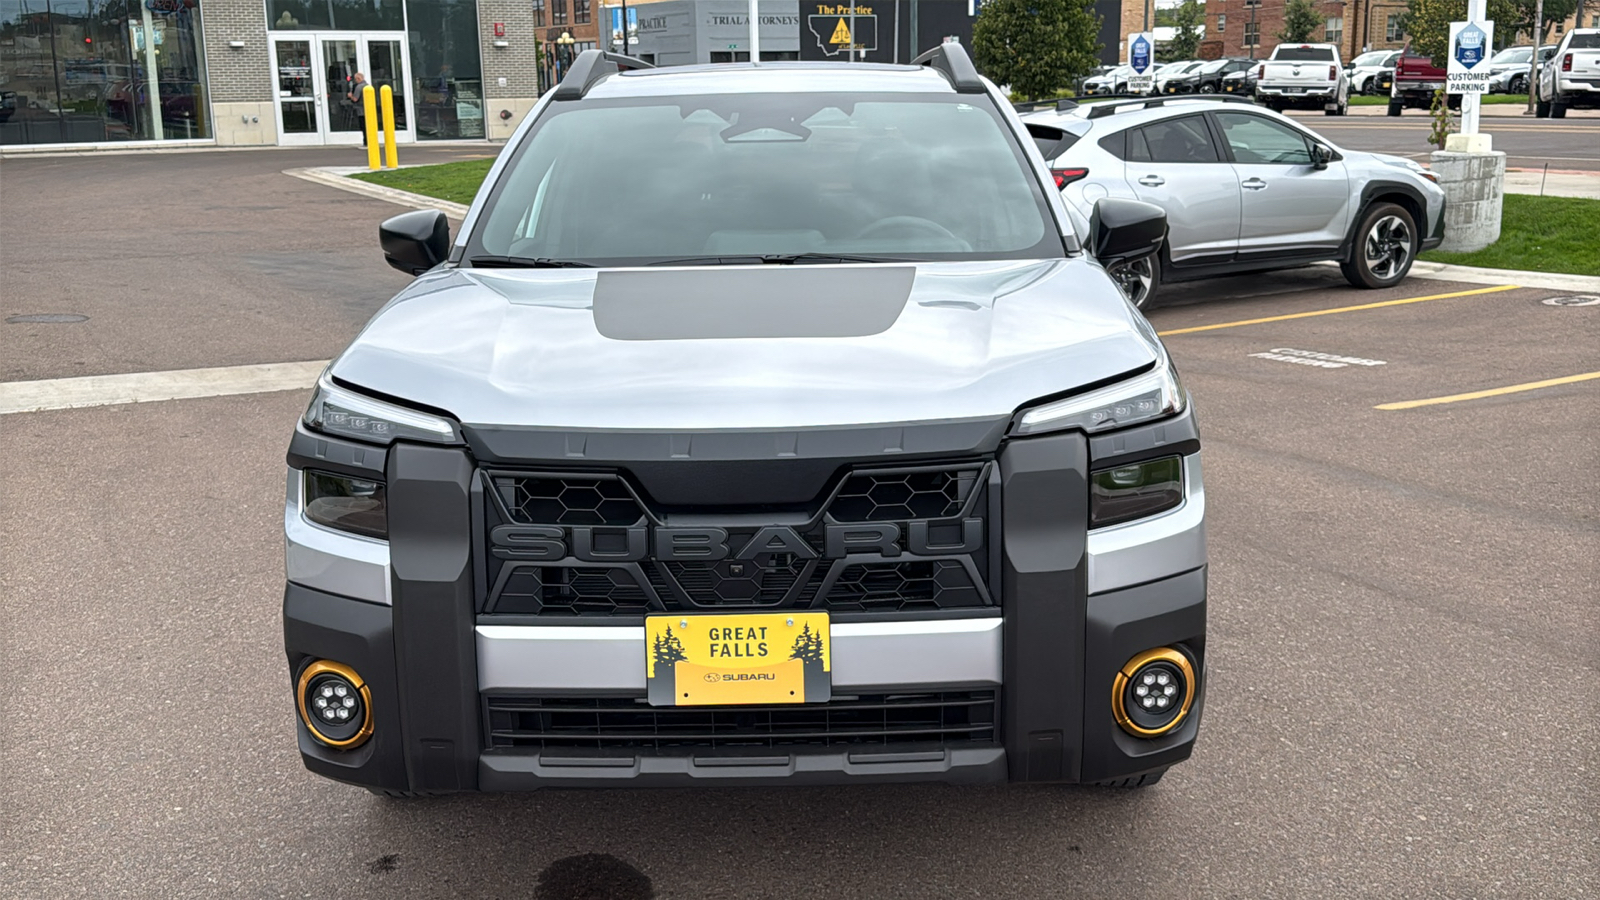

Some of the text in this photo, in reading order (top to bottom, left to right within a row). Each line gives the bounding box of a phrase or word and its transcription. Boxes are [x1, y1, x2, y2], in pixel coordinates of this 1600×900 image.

[816, 5, 835, 14] The
[639, 17, 667, 30] PRACTICE
[712, 16, 799, 25] TRIAL ATORNEYS
[1446, 72, 1490, 81] CUSTOMER
[1450, 83, 1485, 91] PARKING
[491, 517, 982, 562] SUBARU
[709, 627, 768, 641] GREAT
[710, 643, 769, 658] FALLS
[722, 673, 776, 681] SUBARU
